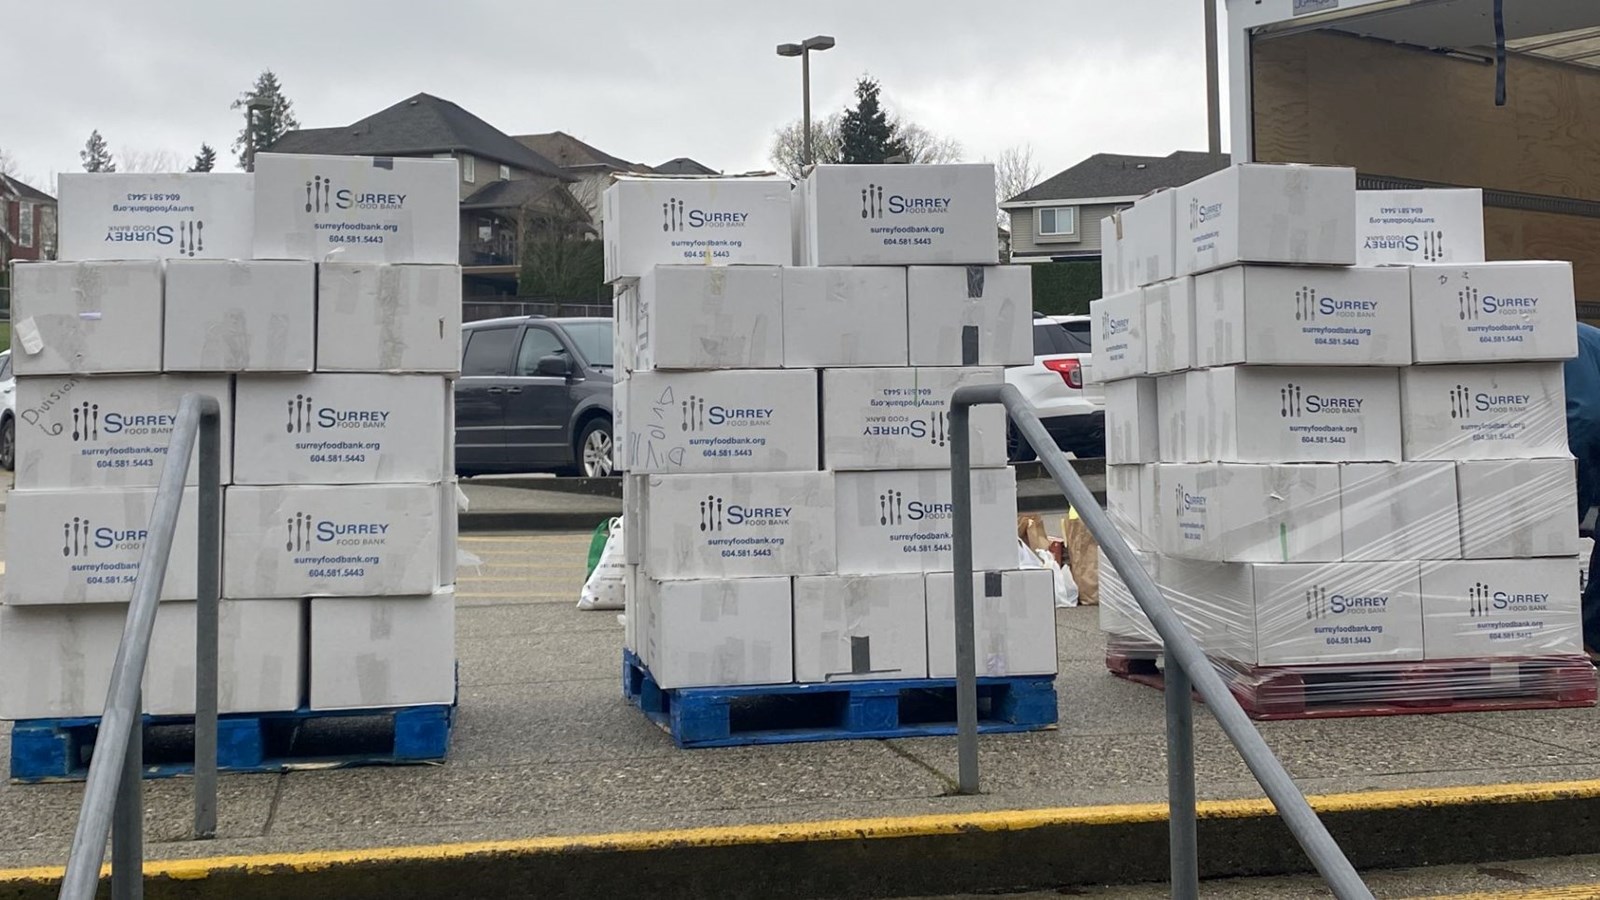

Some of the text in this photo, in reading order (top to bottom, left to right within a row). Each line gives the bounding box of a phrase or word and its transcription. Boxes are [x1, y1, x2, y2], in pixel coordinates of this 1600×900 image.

[336, 189, 406, 209] SURREY
[889, 195, 951, 214] SURREY
[113, 204, 194, 213] surreyfoodbank.org
[314, 222, 398, 232] surreyfoodbank.org
[689, 210, 748, 227] SURREY
[105, 226, 174, 244] SURREY
[1364, 235, 1419, 251] SURREY
[1320, 298, 1378, 315] SURREY
[1483, 296, 1538, 313] SURREY
[1303, 327, 1371, 335] surreyfoodbank.org
[1306, 395, 1363, 413] SURREY
[1475, 393, 1530, 411] SURREY
[104, 413, 176, 434] SURREY
[318, 408, 390, 428] SURREY
[709, 406, 773, 425] SURREY
[863, 420, 926, 438] SURREY
[296, 442, 380, 450] surreyfoodbank.org
[689, 437, 766, 447] surreyfoodbank.org
[97, 459, 153, 468] 604.581.5443
[727, 505, 792, 525] SURREY
[908, 501, 952, 520] SURR
[95, 527, 148, 548] SURR
[317, 522, 389, 541] SURREY
[890, 532, 953, 541] surreyfoodbank.
[708, 537, 784, 546] surreyfoodbank.org
[903, 544, 951, 552] 604.581.5443
[72, 562, 139, 572] surreyfoodban
[294, 556, 379, 564] surreyfoodbank.org
[87, 576, 137, 584] 604.581.54
[309, 569, 364, 577] 604.581.5443
[1331, 595, 1388, 613] SURREY
[1493, 592, 1548, 609] SURREY
[1314, 625, 1382, 634] surreyfoodbank.org
